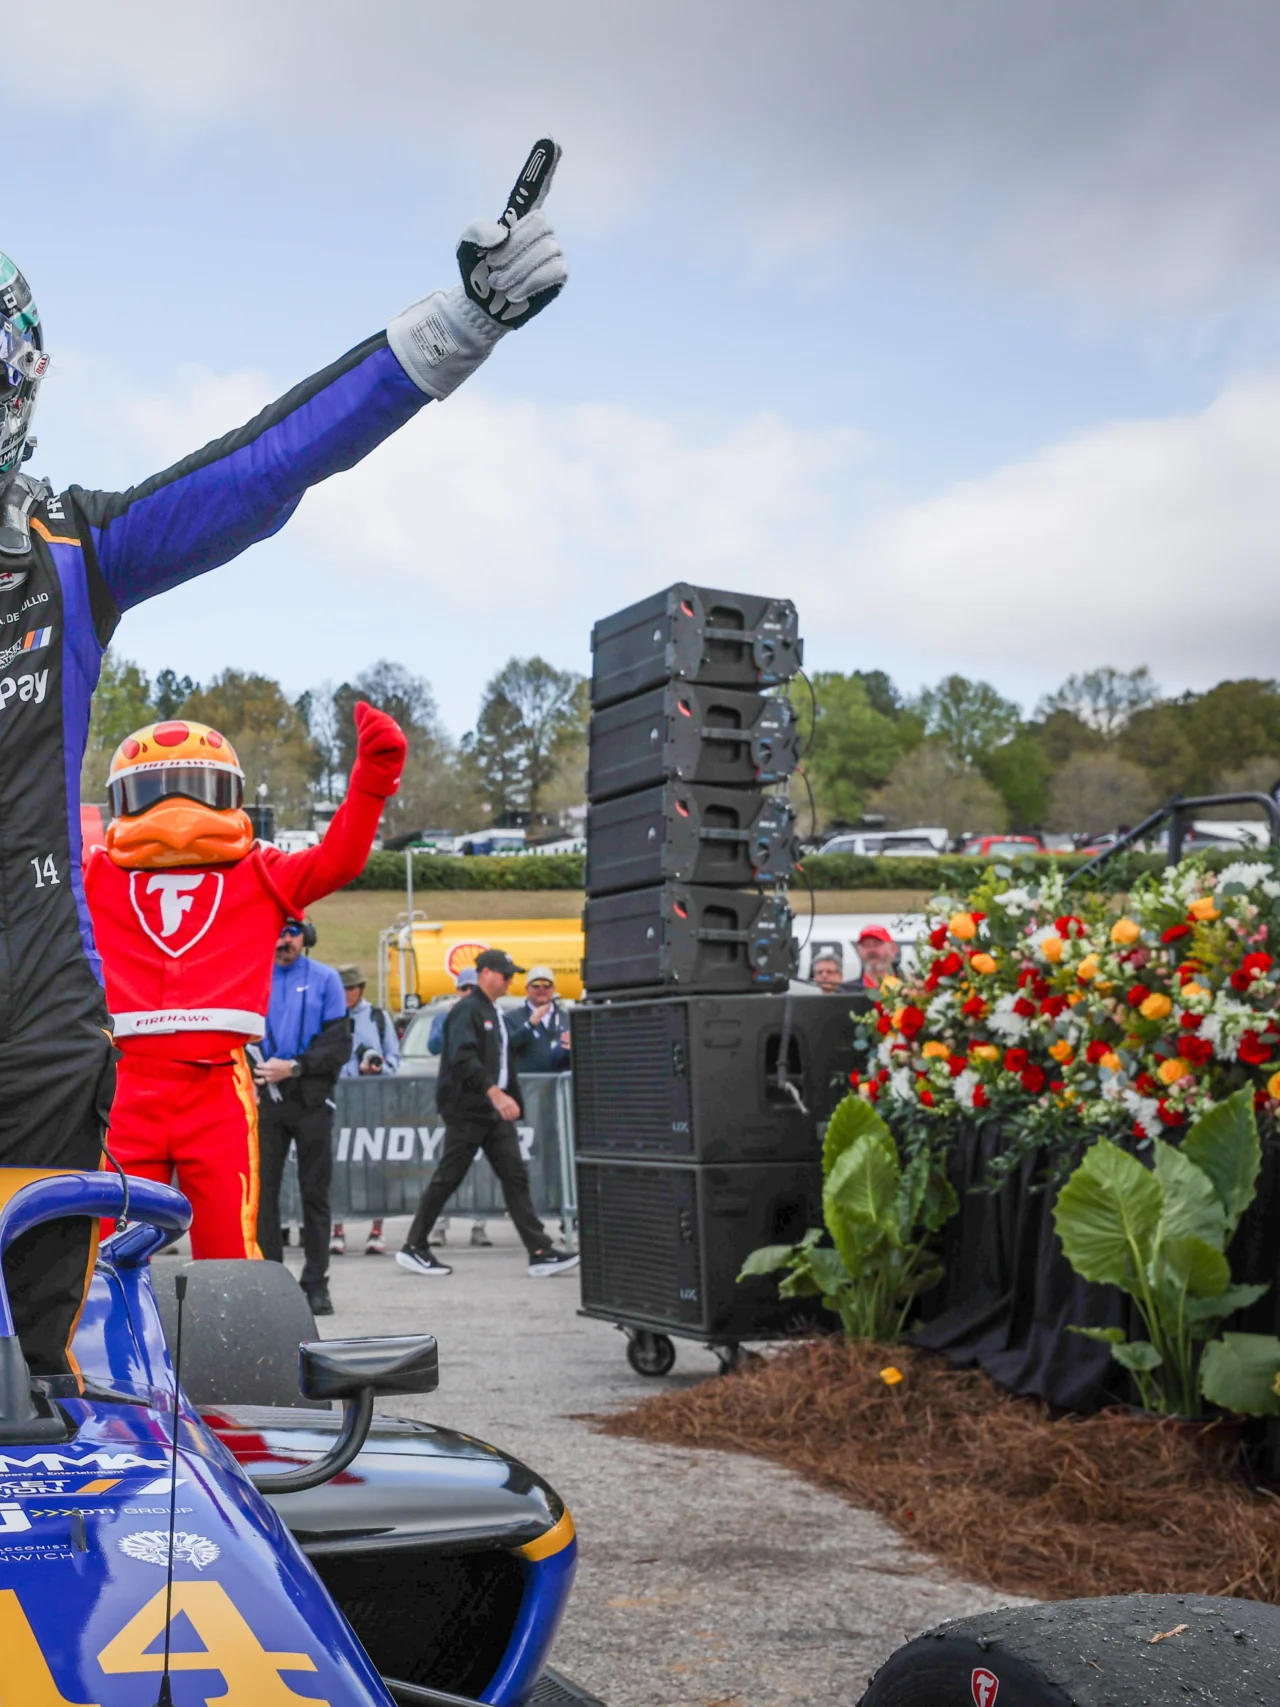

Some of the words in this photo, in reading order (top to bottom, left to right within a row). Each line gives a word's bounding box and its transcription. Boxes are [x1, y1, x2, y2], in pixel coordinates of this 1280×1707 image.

[35, 357, 48, 375] BELL
[6, 612, 20, 623] DE
[135, 760, 217, 771] FIREHAWK
[30, 853, 61, 888] 14
[136, 1015, 211, 1027] FIREHAWK
[46, 1469, 125, 1477] Entertainment
[123, 1507, 194, 1515] GROUP
